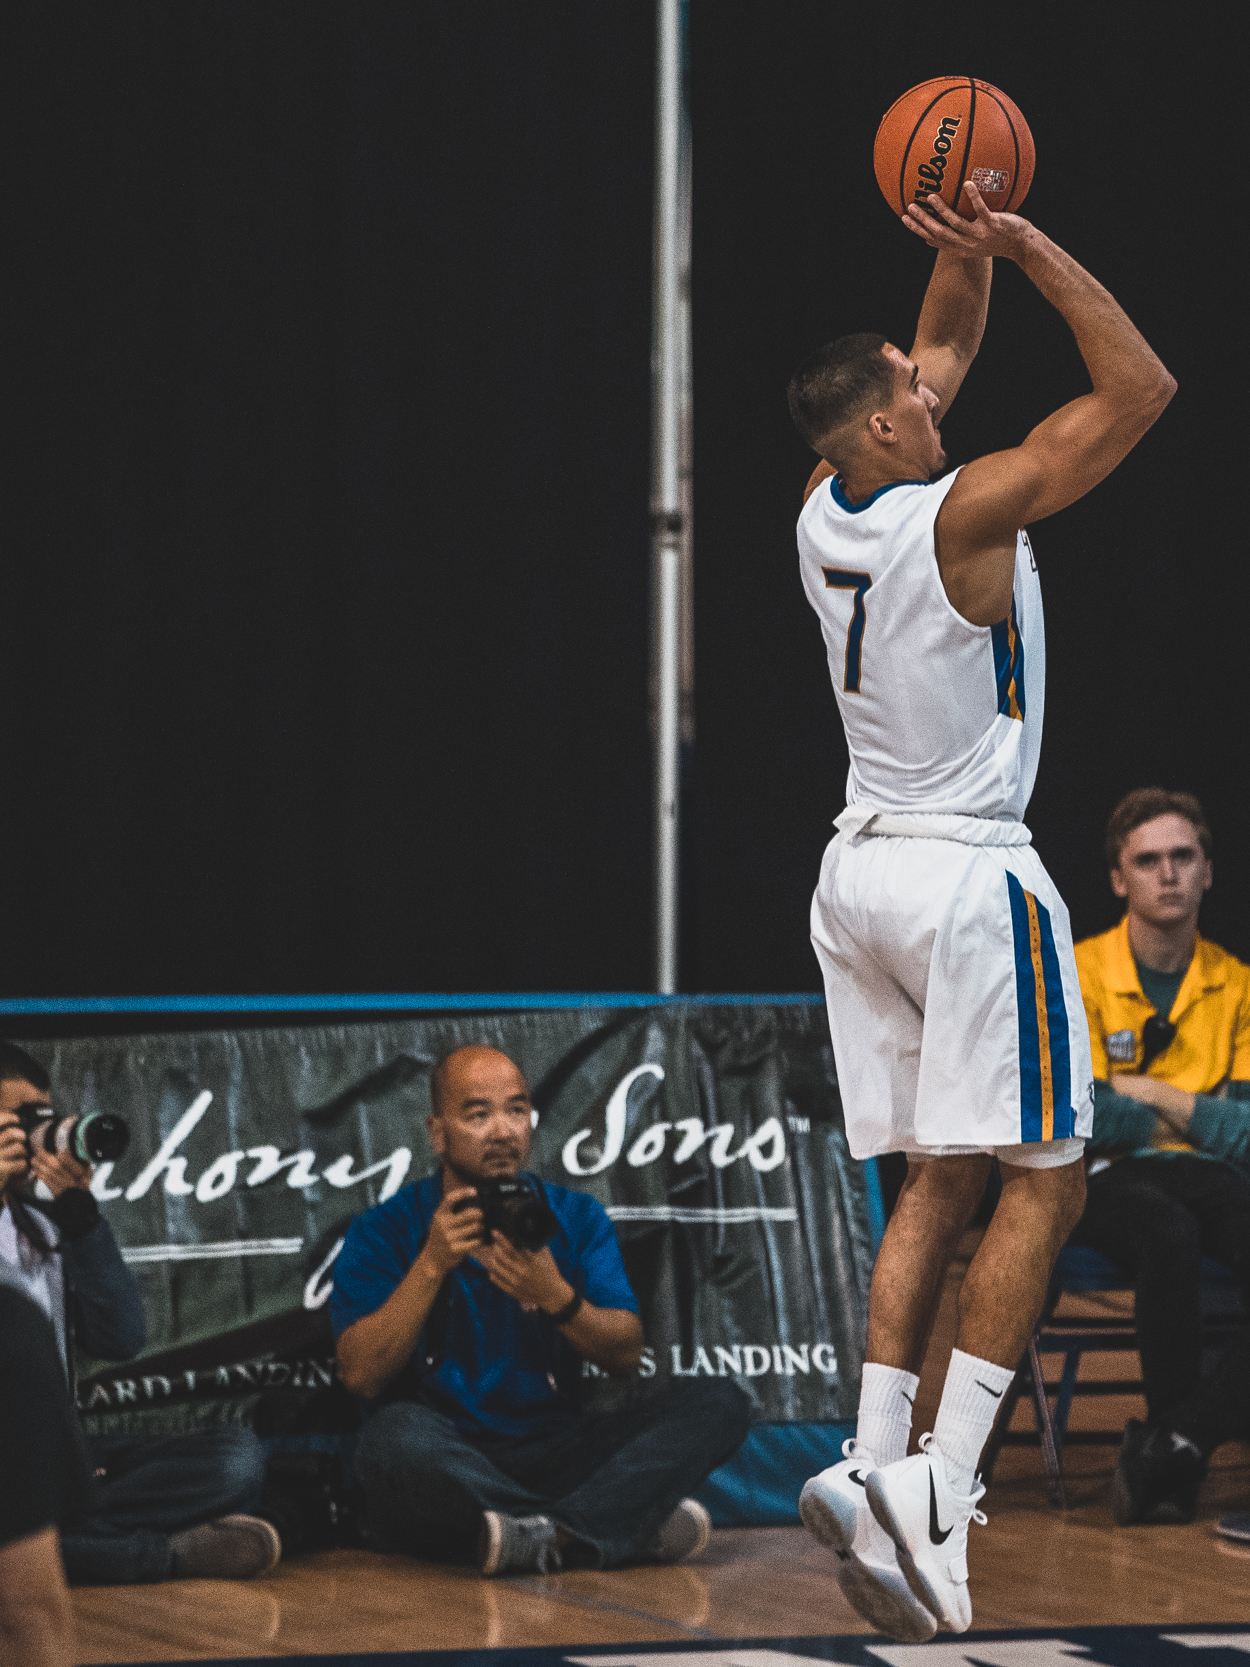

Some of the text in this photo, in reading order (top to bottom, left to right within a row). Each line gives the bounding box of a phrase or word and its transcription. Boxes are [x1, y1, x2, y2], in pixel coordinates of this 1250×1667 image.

[820, 566, 873, 694] 7
[562, 1062, 786, 1177] Sons
[671, 1342, 838, 1378] LANDING
